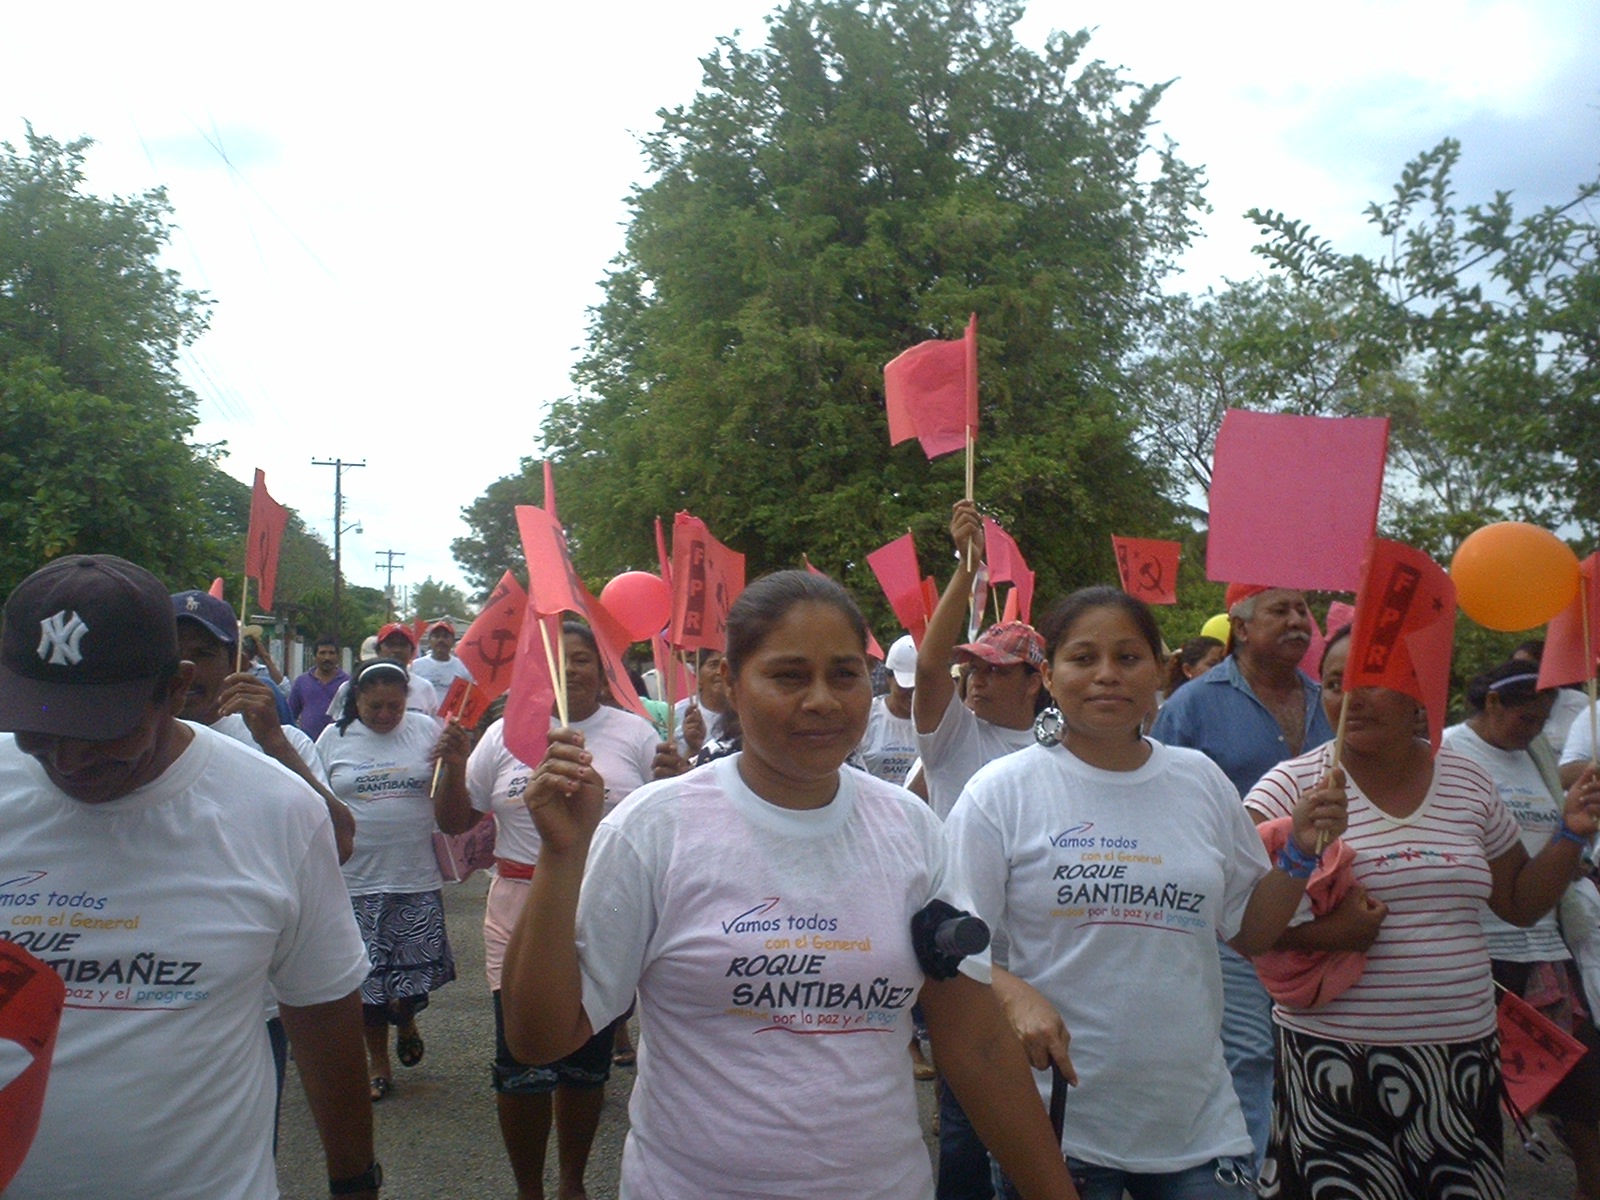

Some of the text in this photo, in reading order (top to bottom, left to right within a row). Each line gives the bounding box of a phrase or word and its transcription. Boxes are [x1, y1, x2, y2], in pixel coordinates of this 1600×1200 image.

[686, 547, 704, 629] FPR
[1049, 829, 1138, 849] Vamos todos
[1053, 864, 1128, 880] ROQUE
[0, 891, 107, 910] mos todos
[1057, 882, 1205, 913] SANTIBAÑEZ
[11, 912, 140, 930] con el General
[722, 908, 838, 934] Vamos todos
[1088, 907, 1107, 919] por
[1111, 906, 1120, 917] la
[1123, 908, 1142, 919] paz
[1144, 910, 1151, 921] y
[1153, 910, 1163, 920] el
[765, 935, 872, 952] con el General
[40, 952, 202, 986] TIBAÑEZ
[725, 954, 826, 978] ROQUE
[99, 990, 109, 1003] y
[115, 986, 130, 1000] el
[732, 977, 914, 1010] SANTIBAÑEZ
[801, 1010, 813, 1025] la
[817, 1012, 839, 1027] paz
[843, 1015, 852, 1028] y
